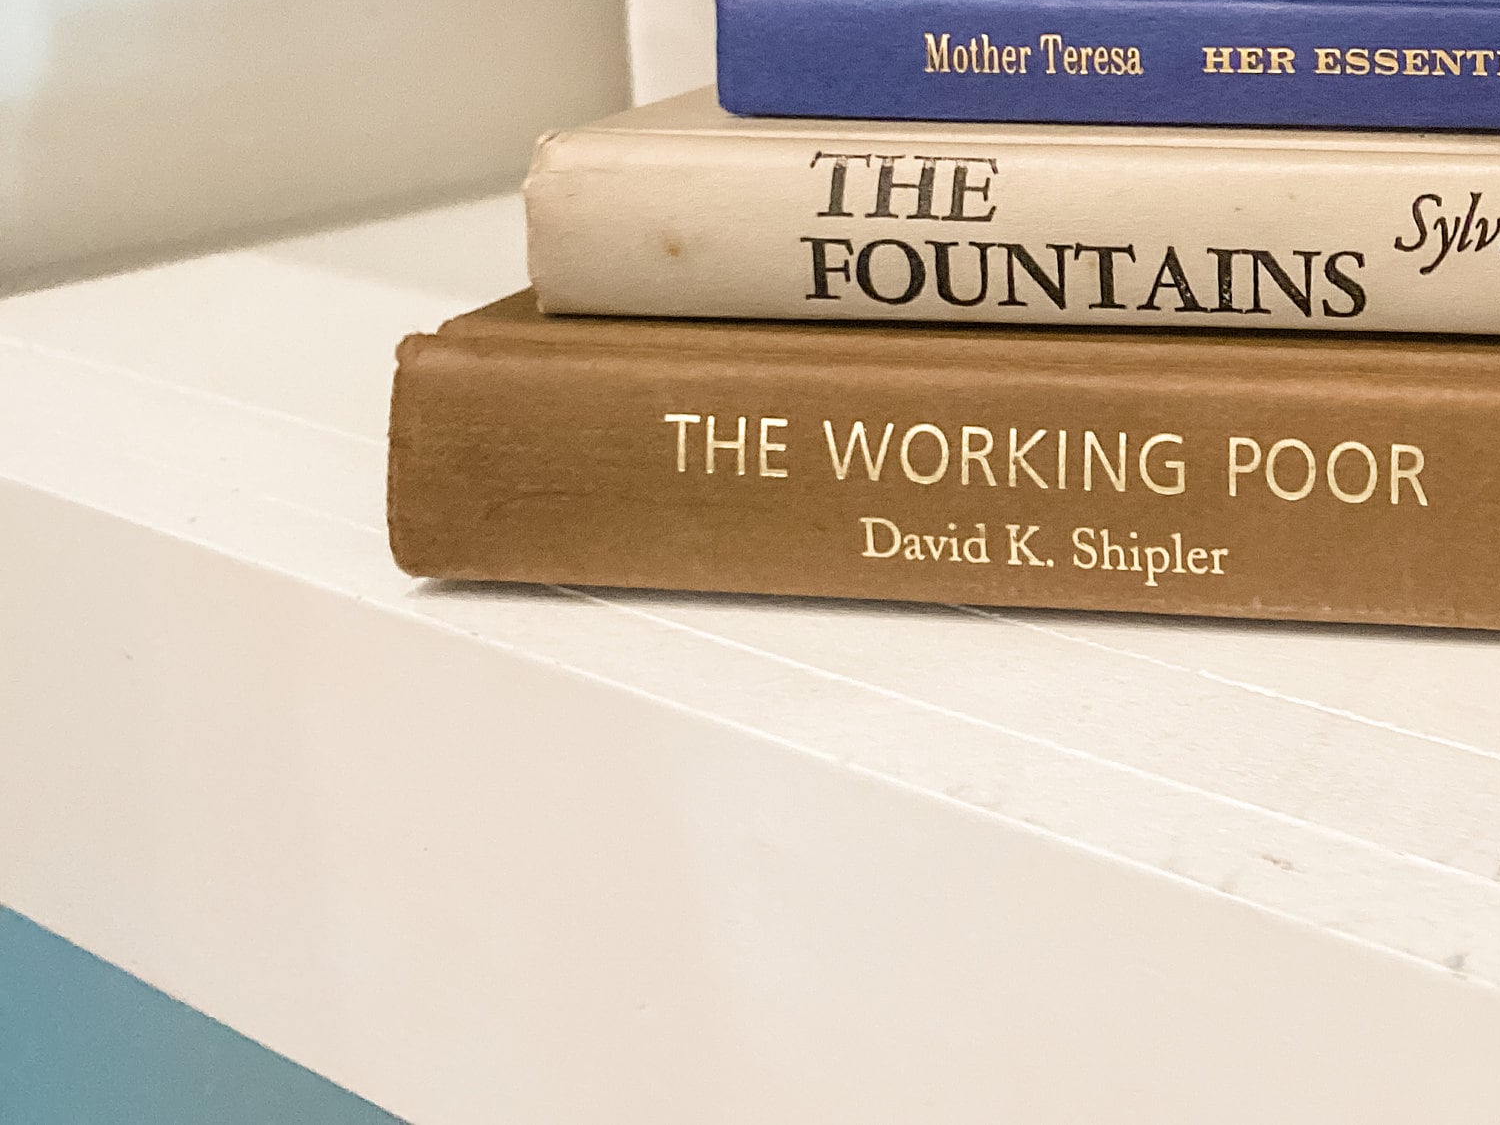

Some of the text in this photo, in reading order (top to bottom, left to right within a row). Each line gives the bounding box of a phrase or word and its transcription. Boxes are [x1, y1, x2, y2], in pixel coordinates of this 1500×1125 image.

[925, 34, 1143, 75] Mother Teresa
[1202, 48, 1295, 73] HER
[810, 151, 998, 222] THE
[800, 237, 1367, 318] FOUNTAINS
[665, 414, 1427, 506] THE WORKING POOR
[860, 518, 1228, 586] David K. Shipler
